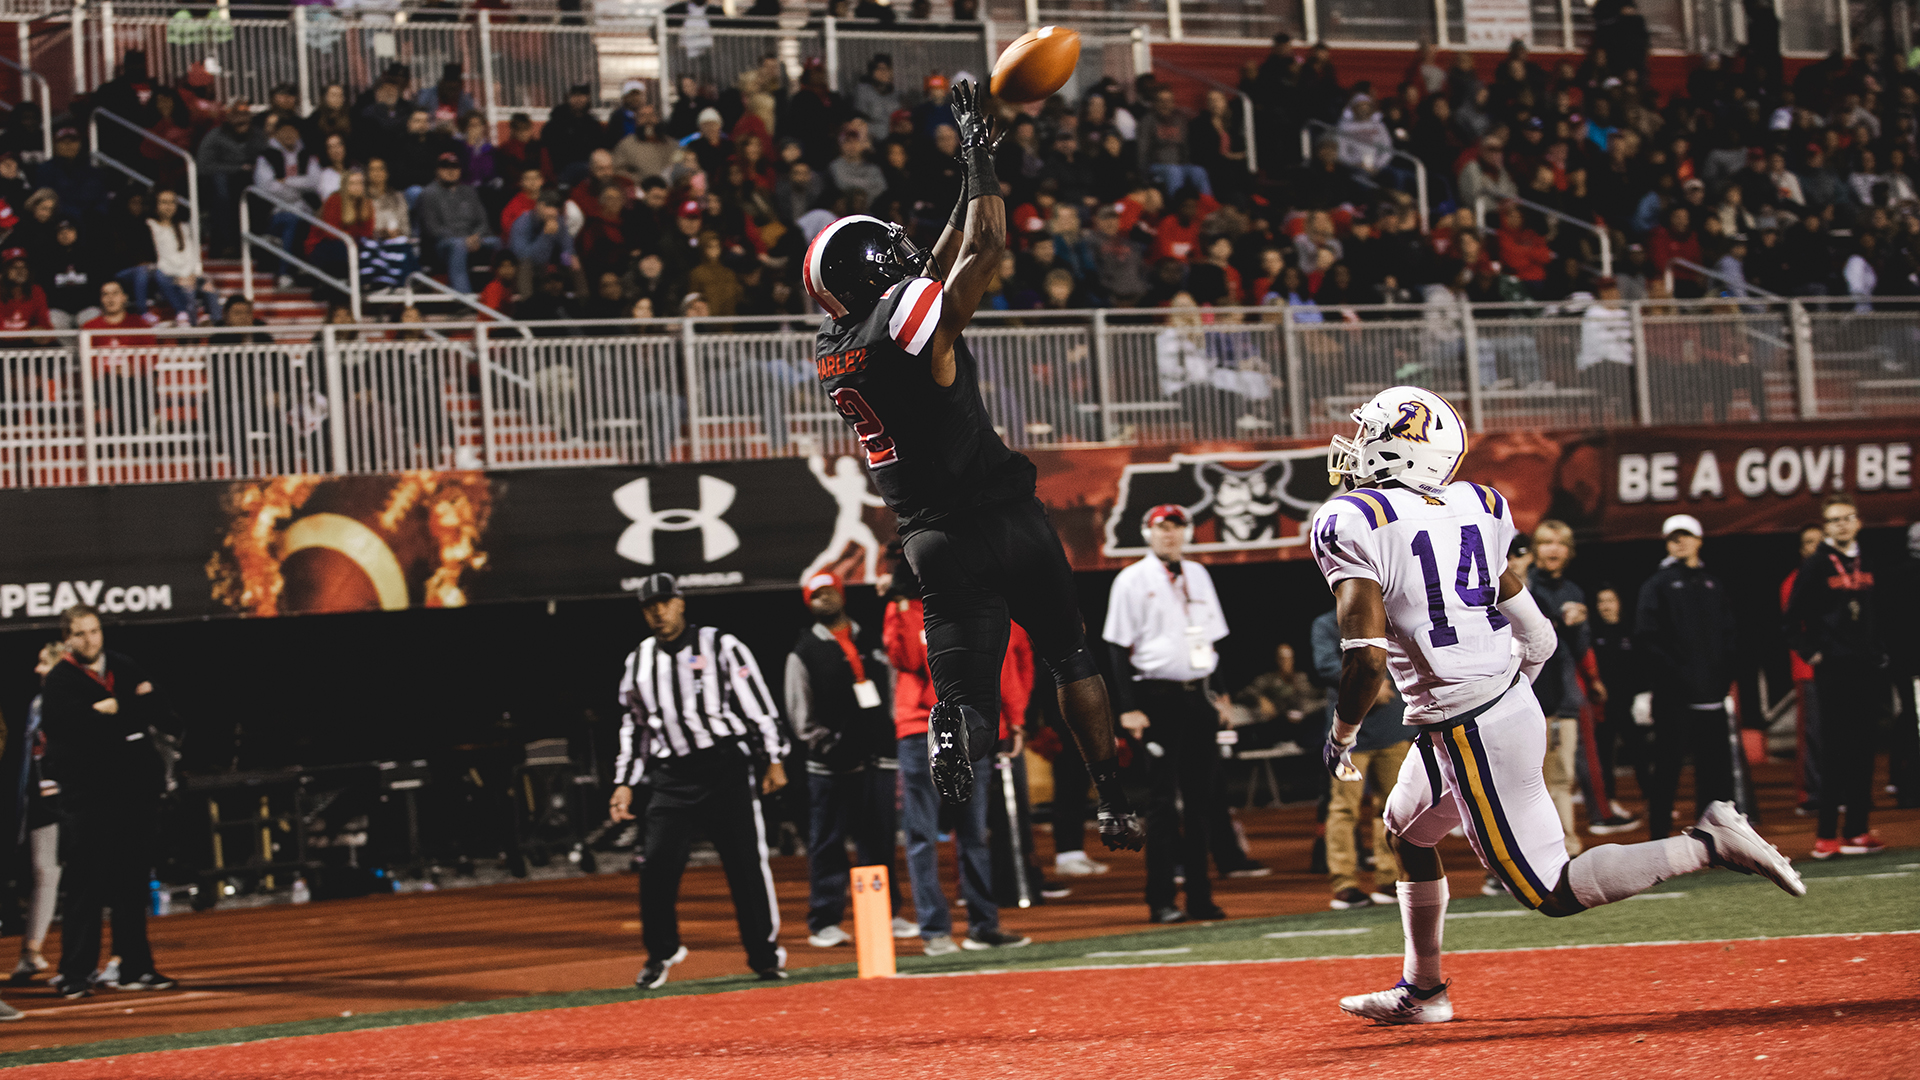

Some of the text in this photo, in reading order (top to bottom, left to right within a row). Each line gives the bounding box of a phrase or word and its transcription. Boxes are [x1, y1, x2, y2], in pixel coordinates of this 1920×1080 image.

[830, 387, 898, 469] 2
[1618, 442, 1912, 503] BE A GOV! BE
[1314, 513, 1342, 558] 14
[1411, 523, 1510, 648] 14
